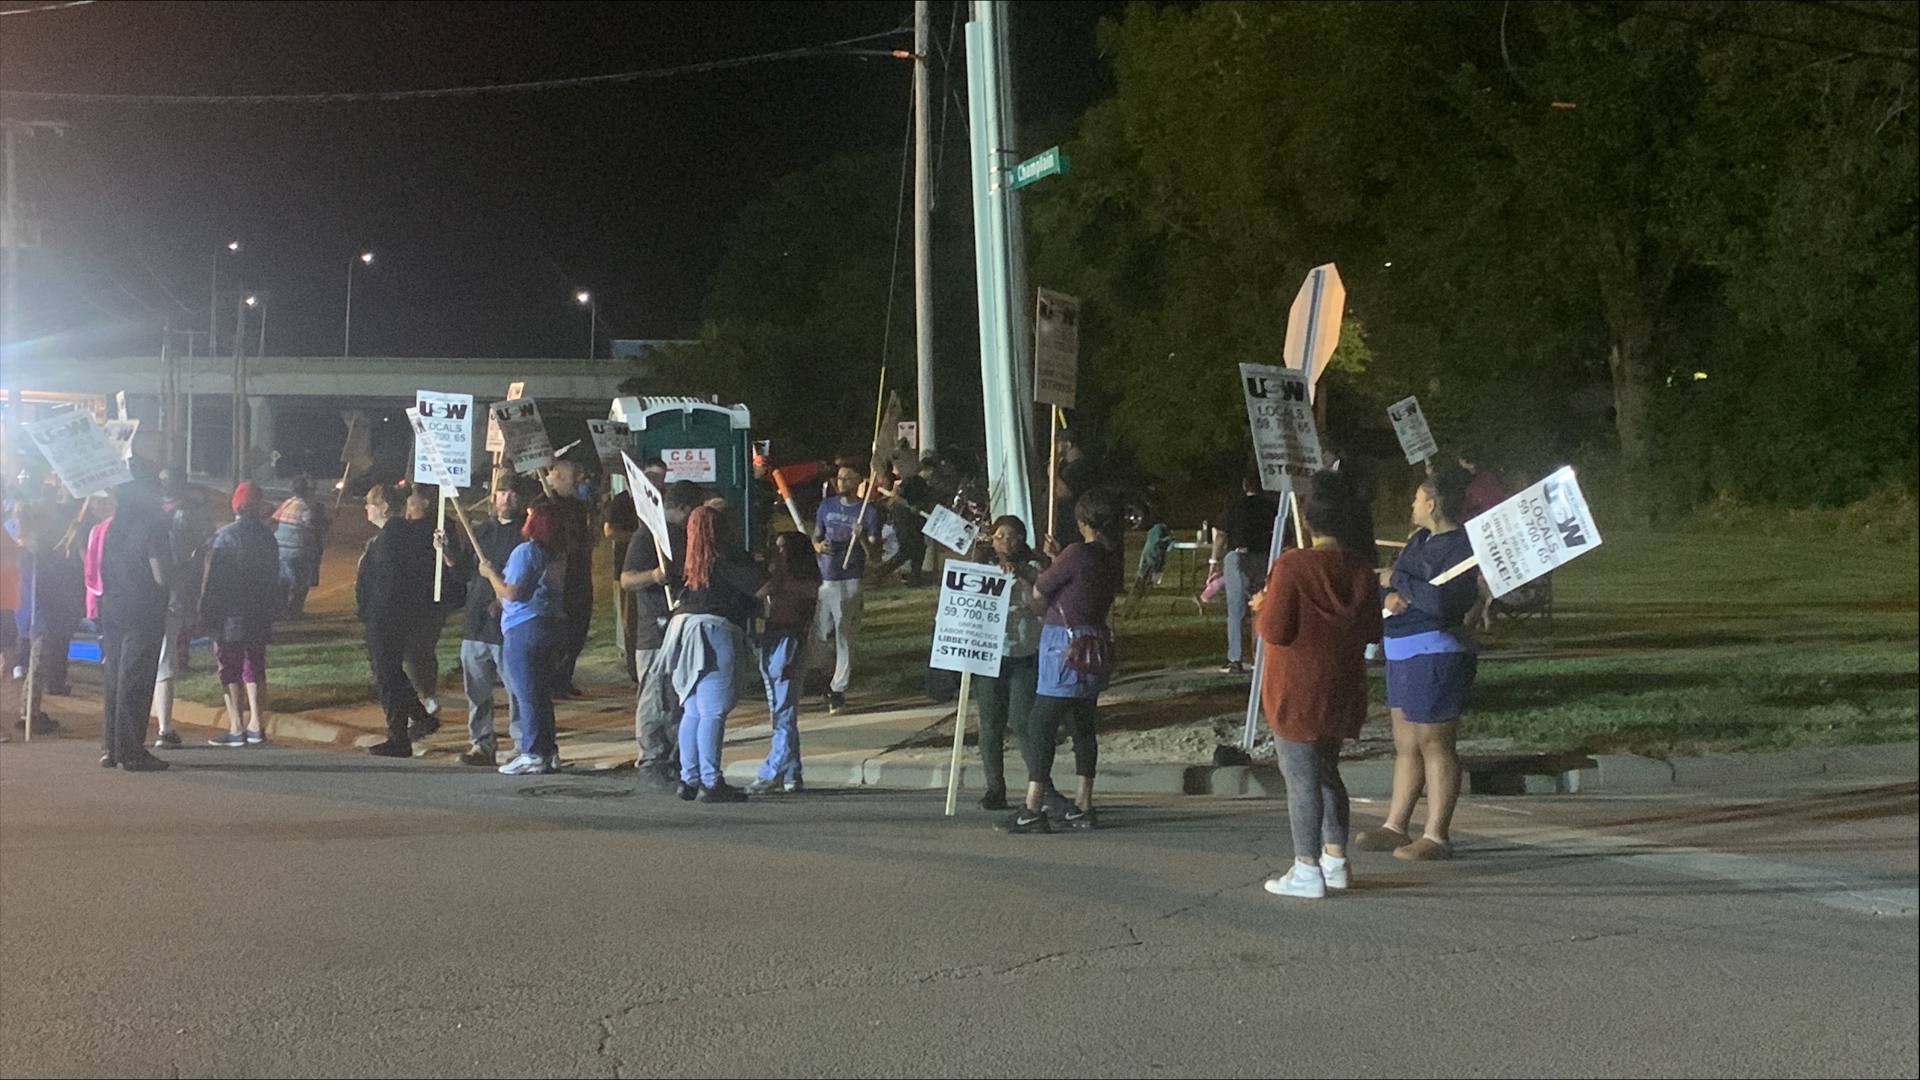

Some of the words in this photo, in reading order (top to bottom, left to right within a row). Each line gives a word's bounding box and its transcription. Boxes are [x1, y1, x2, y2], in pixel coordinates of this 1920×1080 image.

[1017, 154, 1055, 182] Champlain
[1247, 377, 1304, 402] USW
[419, 400, 468, 420] USW
[429, 422, 462, 433] OCALS
[454, 434, 466, 442] 65
[671, 450, 680, 461] C
[685, 450, 694, 461] &
[698, 450, 706, 461] L
[1543, 481, 1587, 548] USW
[1517, 499, 1530, 520] 59,
[1525, 521, 1541, 548] 700,
[1537, 547, 1551, 564] 65
[1529, 498, 1559, 553] LOCALS
[1510, 536, 1531, 574] PRACTICE
[1504, 549, 1524, 580] GLASS
[946, 571, 1007, 597] USW
[949, 596, 998, 611] LOCALS
[944, 606, 960, 619] 59,
[963, 608, 985, 621] 700,
[987, 613, 1000, 623] 65
[940, 627, 965, 635] LABOR
[965, 629, 998, 640] PRACTICE
[958, 621, 983, 630] UNFAIR
[938, 635, 969, 645] LIBBEY
[971, 640, 998, 649] GLASS
[936, 645, 997, 662] -STRIKE!-
